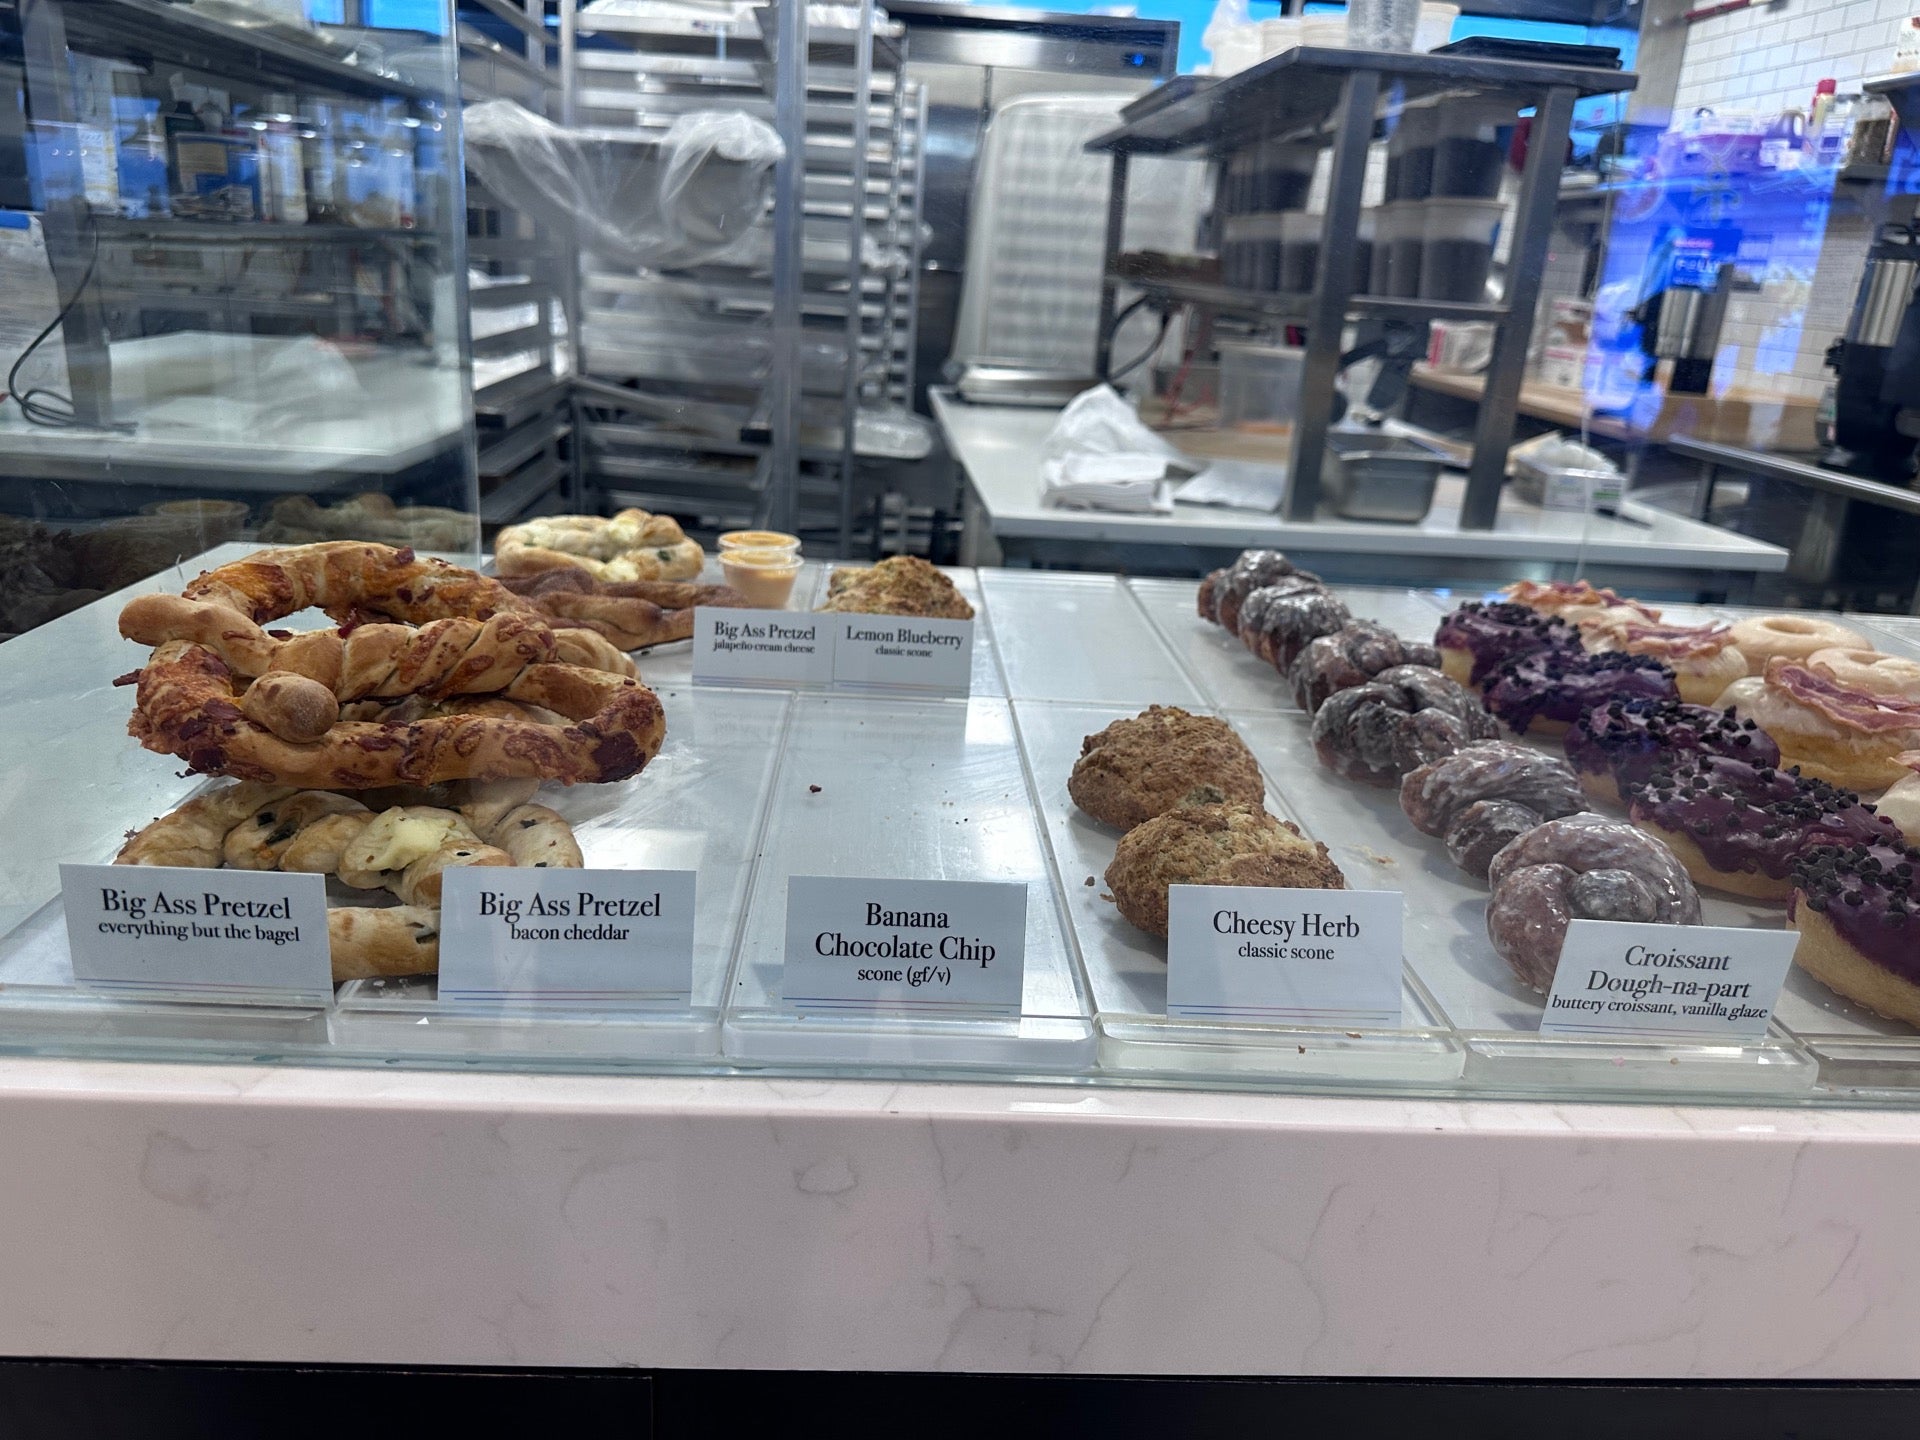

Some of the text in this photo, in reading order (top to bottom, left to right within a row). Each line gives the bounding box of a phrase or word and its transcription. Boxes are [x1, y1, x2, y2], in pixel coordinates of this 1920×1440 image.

[715, 621, 816, 640] Big Ass Pretzel
[846, 625, 964, 650] Lemon Blueberry
[713, 639, 816, 654] jalapeño cream cheese
[875, 645, 933, 658] classic scone
[100, 888, 291, 920] Big Ass Pretzel
[479, 891, 662, 924] Big Ass Pretzel
[865, 902, 950, 929] Banana
[98, 919, 300, 946] everything but the bagel
[511, 923, 630, 941] bacon cheddar
[1213, 910, 1360, 943] Cheesy Herb
[814, 931, 996, 968] Chocolate Chip
[1238, 942, 1335, 960] classic scone
[1624, 945, 1732, 971] Croissant
[857, 965, 952, 987] scone (gf/v)
[1585, 970, 1752, 1002] Dough-na-part
[1551, 995, 1768, 1021] buttery croissant, vanilla glaze
